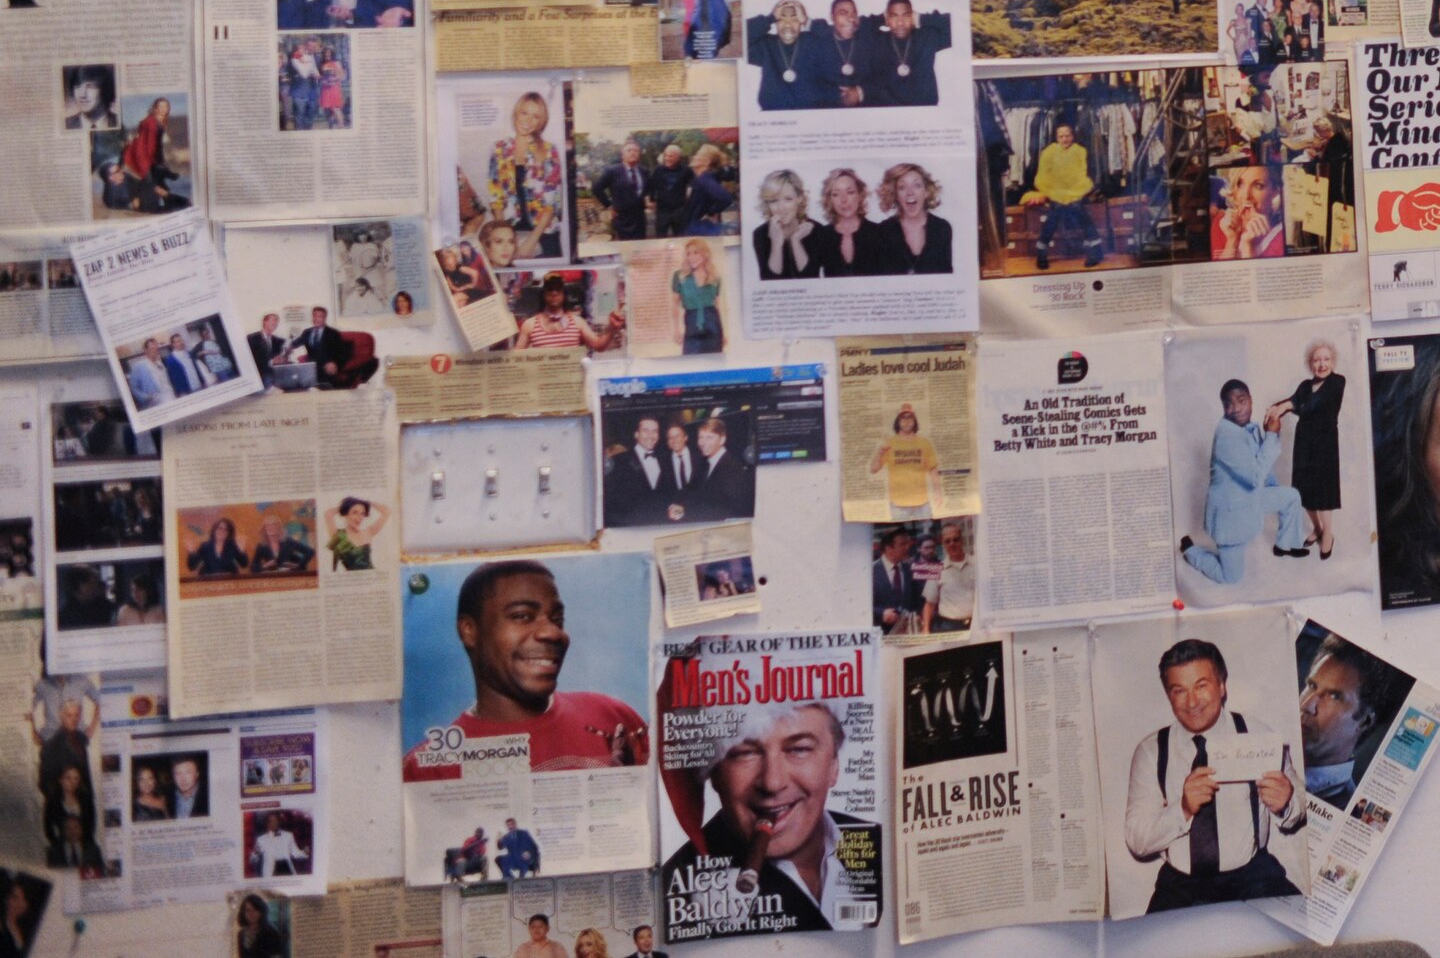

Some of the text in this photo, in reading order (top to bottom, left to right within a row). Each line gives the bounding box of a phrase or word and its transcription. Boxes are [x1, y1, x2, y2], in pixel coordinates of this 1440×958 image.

[1367, 69, 1430, 95] Our
[84, 232, 190, 276] ZAP 2 NEWS & BUZZ
[842, 357, 965, 377] Ladies love cool Judah
[601, 378, 647, 396] People
[1024, 393, 1125, 410] An Old Tradition of
[1002, 405, 1146, 425] Scene-Stealing Comics Gets
[1012, 429, 1018, 437] a
[1021, 424, 1045, 437] Kick
[1049, 425, 1058, 434] in
[1062, 422, 1077, 433] the
[1110, 419, 1138, 430] From
[994, 431, 1157, 452] Betty White and Tracy Morgan
[664, 632, 870, 657] BEST GEAR OF THE YEAR
[671, 650, 864, 707] Men's Journal
[664, 710, 746, 727] Powder for
[664, 724, 738, 742] Everyone!
[418, 746, 528, 765] TRACY MORGAN
[903, 771, 1020, 823] FALL & RISE
[903, 807, 1021, 834] of ALEC BALDWIN
[1307, 800, 1333, 821] Make
[696, 855, 733, 870] How
[667, 865, 728, 896] Alec
[667, 890, 784, 925] Baldwin
[669, 914, 798, 940] Finally Got It Right
